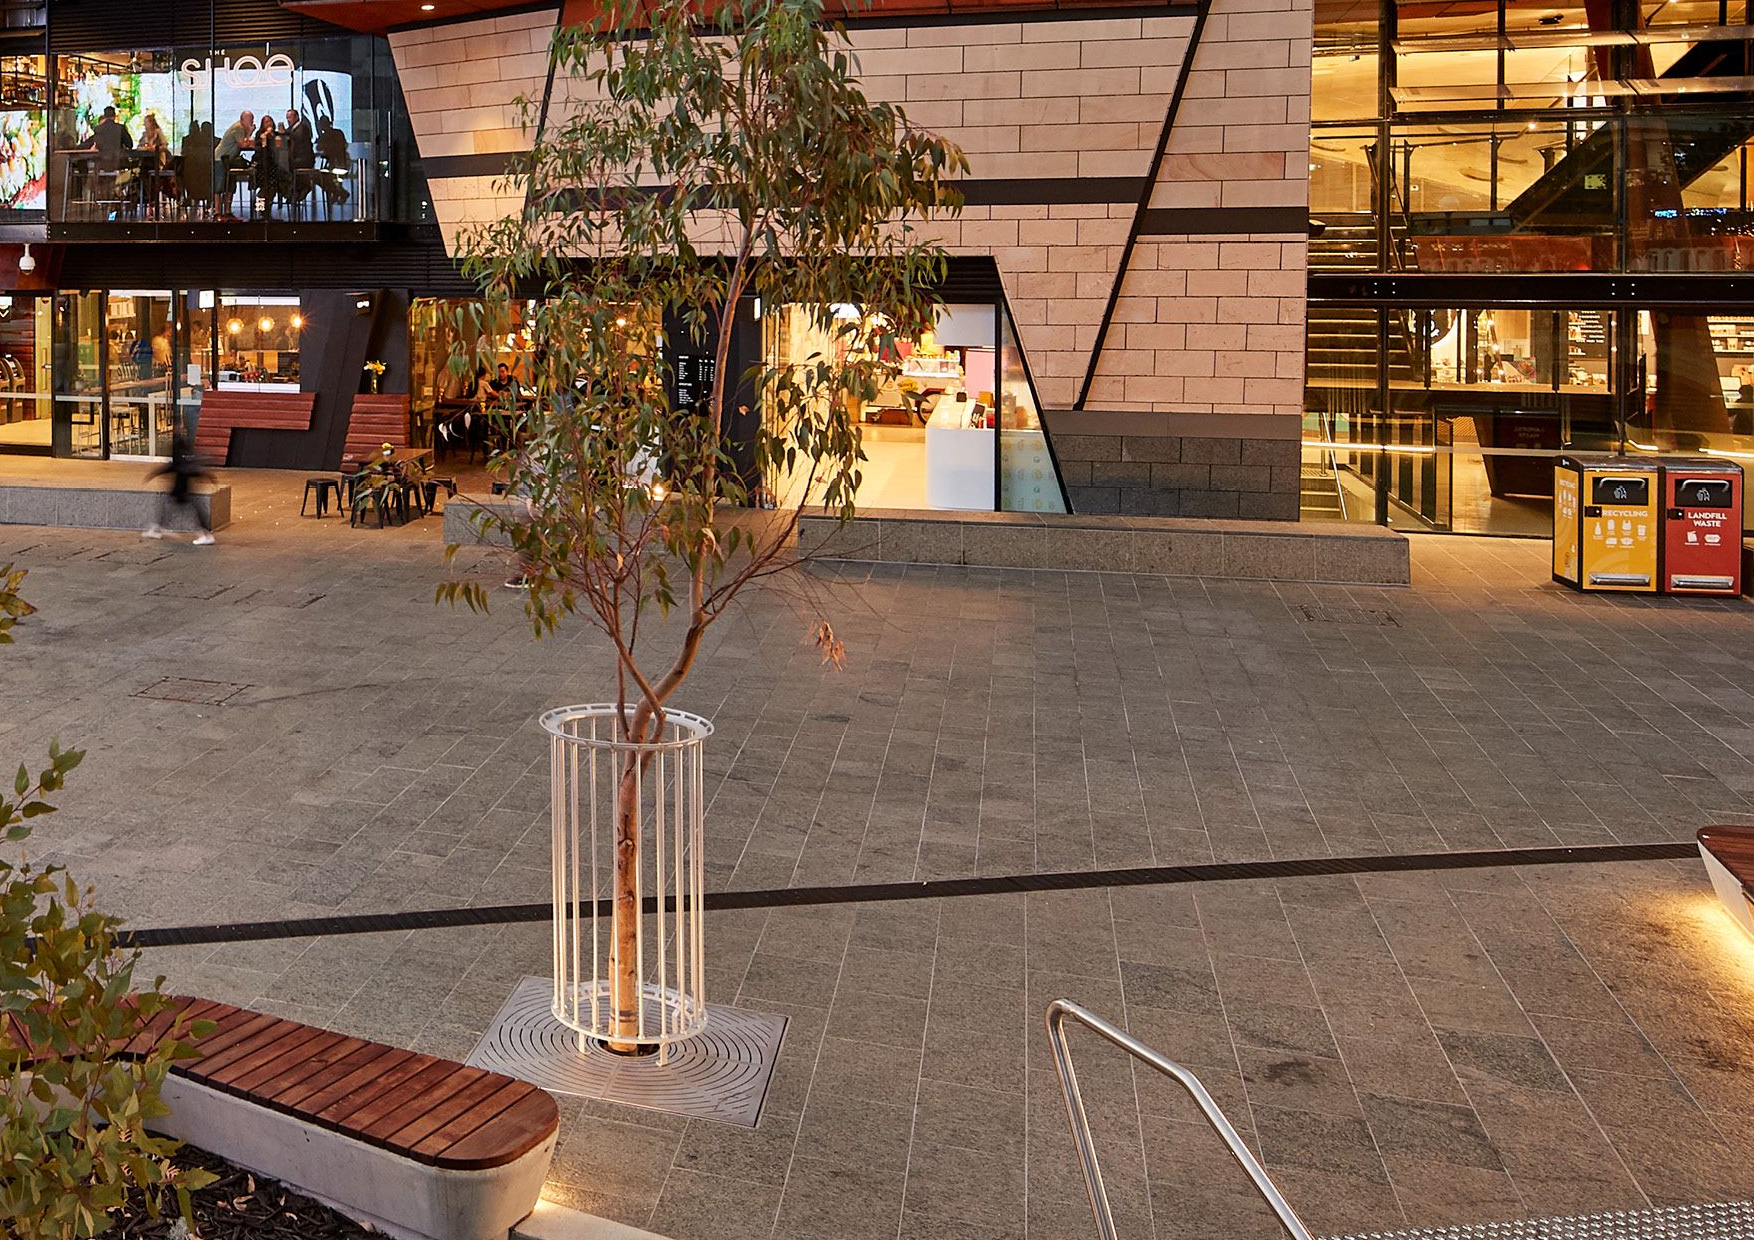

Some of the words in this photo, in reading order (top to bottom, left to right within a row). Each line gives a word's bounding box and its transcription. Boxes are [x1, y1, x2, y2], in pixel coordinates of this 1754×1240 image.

[208, 48, 226, 56] THE
[1602, 509, 1649, 517] RECYCLING
[1687, 512, 1728, 520] LANDFILL
